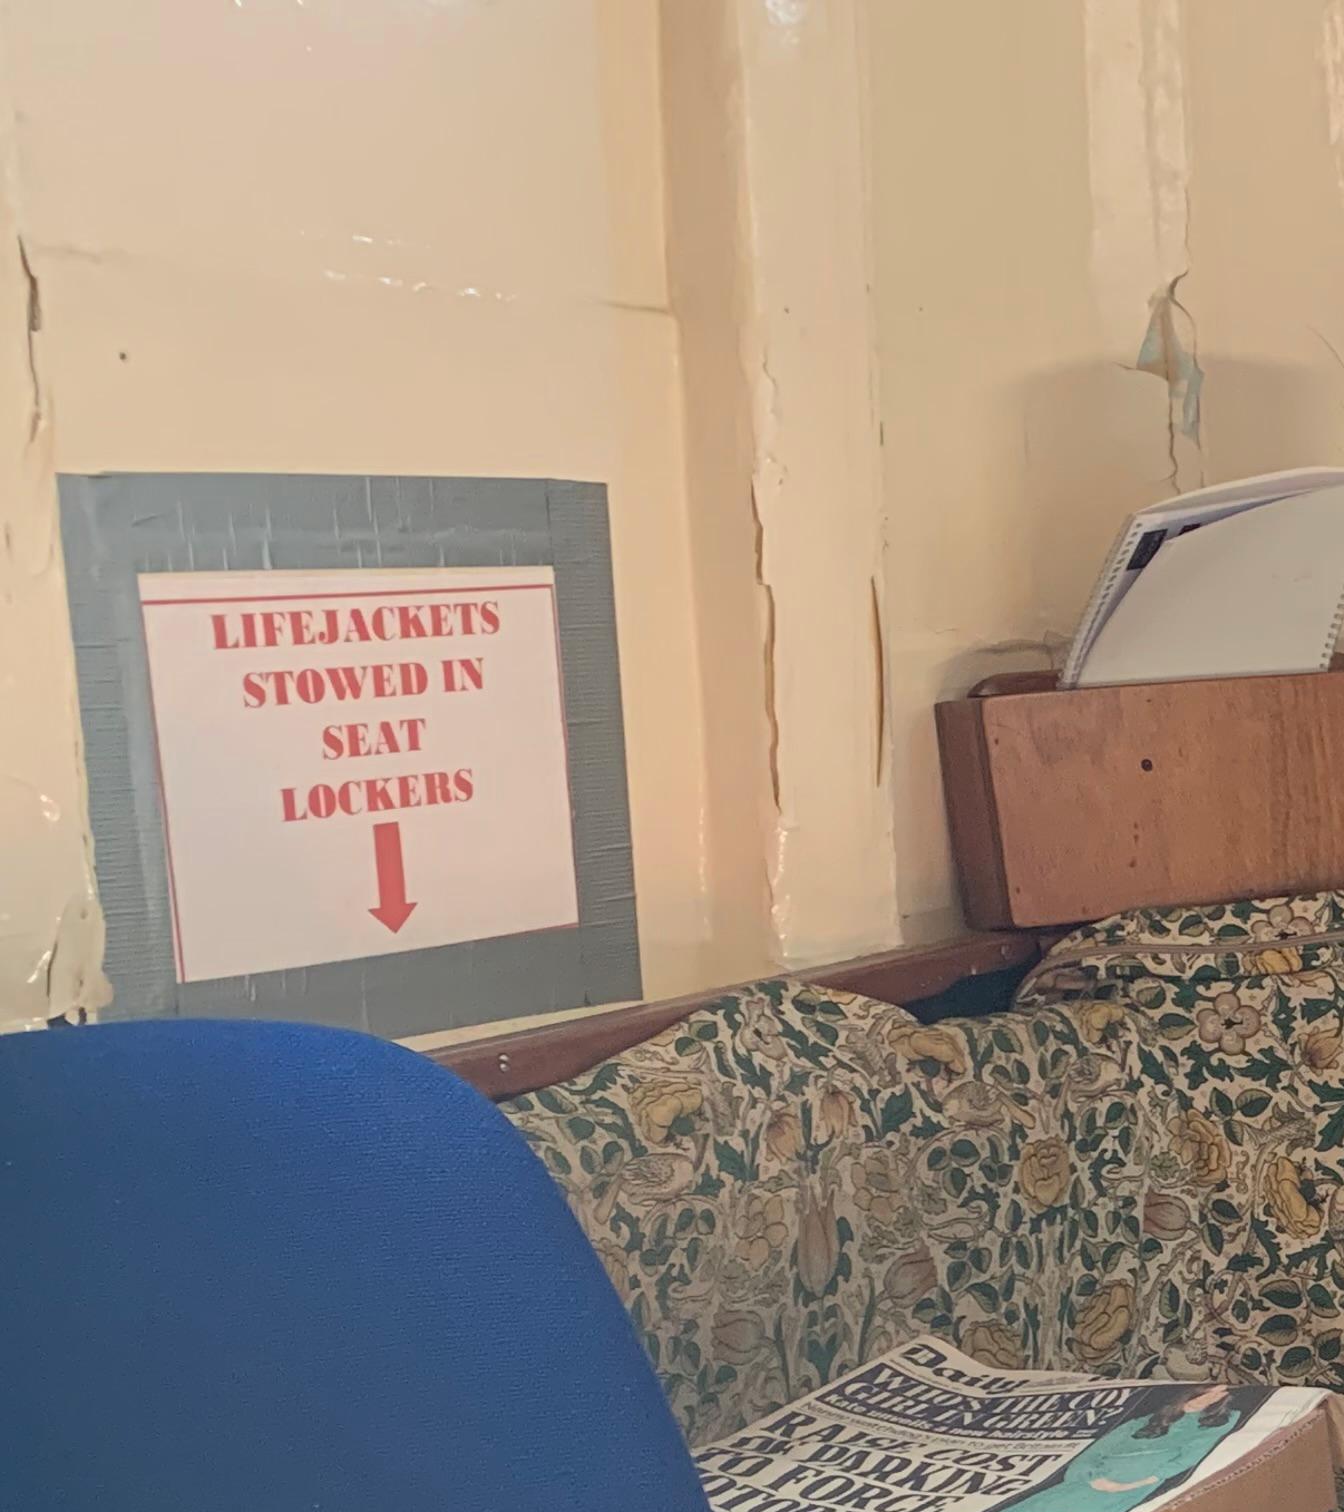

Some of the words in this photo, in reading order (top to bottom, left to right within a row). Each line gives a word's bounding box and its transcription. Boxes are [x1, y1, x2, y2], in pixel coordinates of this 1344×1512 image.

[211, 602, 500, 649] LIFEJACKETS
[242, 662, 429, 709] STOWED
[441, 657, 485, 693] IN
[321, 718, 427, 761] SEAT
[280, 768, 474, 823] LOCKERS
[902, 1343, 1031, 1396] Daily
[844, 1382, 929, 1418] GIRL
[932, 1408, 986, 1427] IN
[983, 1406, 1124, 1430] GREEN?
[991, 1393, 1062, 1413] THE
[1068, 1387, 1133, 1411] COY
[697, 1447, 774, 1477] TO
[760, 1410, 927, 1454] RAISE
[924, 1449, 1063, 1476] COST
[792, 1444, 1033, 1496] PARKING
